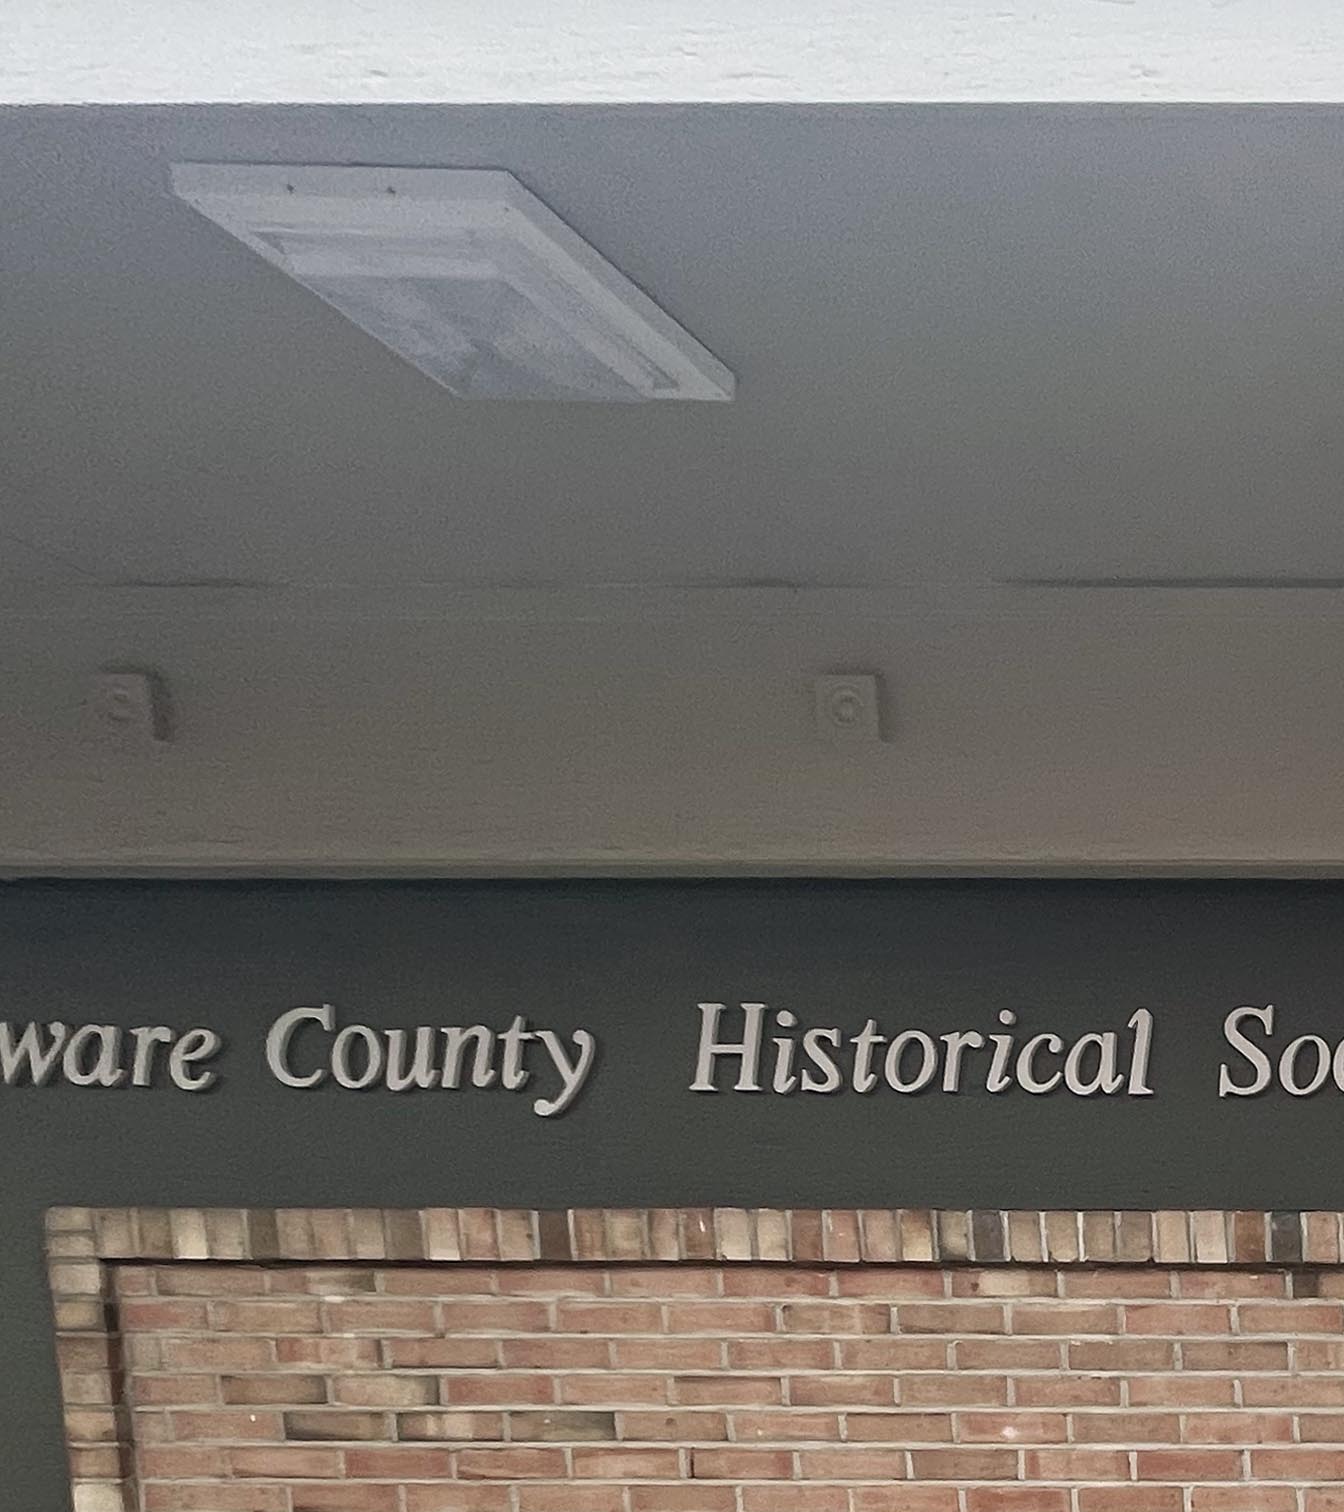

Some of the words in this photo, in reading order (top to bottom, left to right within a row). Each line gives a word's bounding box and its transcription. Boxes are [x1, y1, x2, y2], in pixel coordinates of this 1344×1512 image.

[0, 1020, 222, 1092] ware
[266, 1004, 597, 1118] County
[688, 1001, 1156, 1097] Historical
